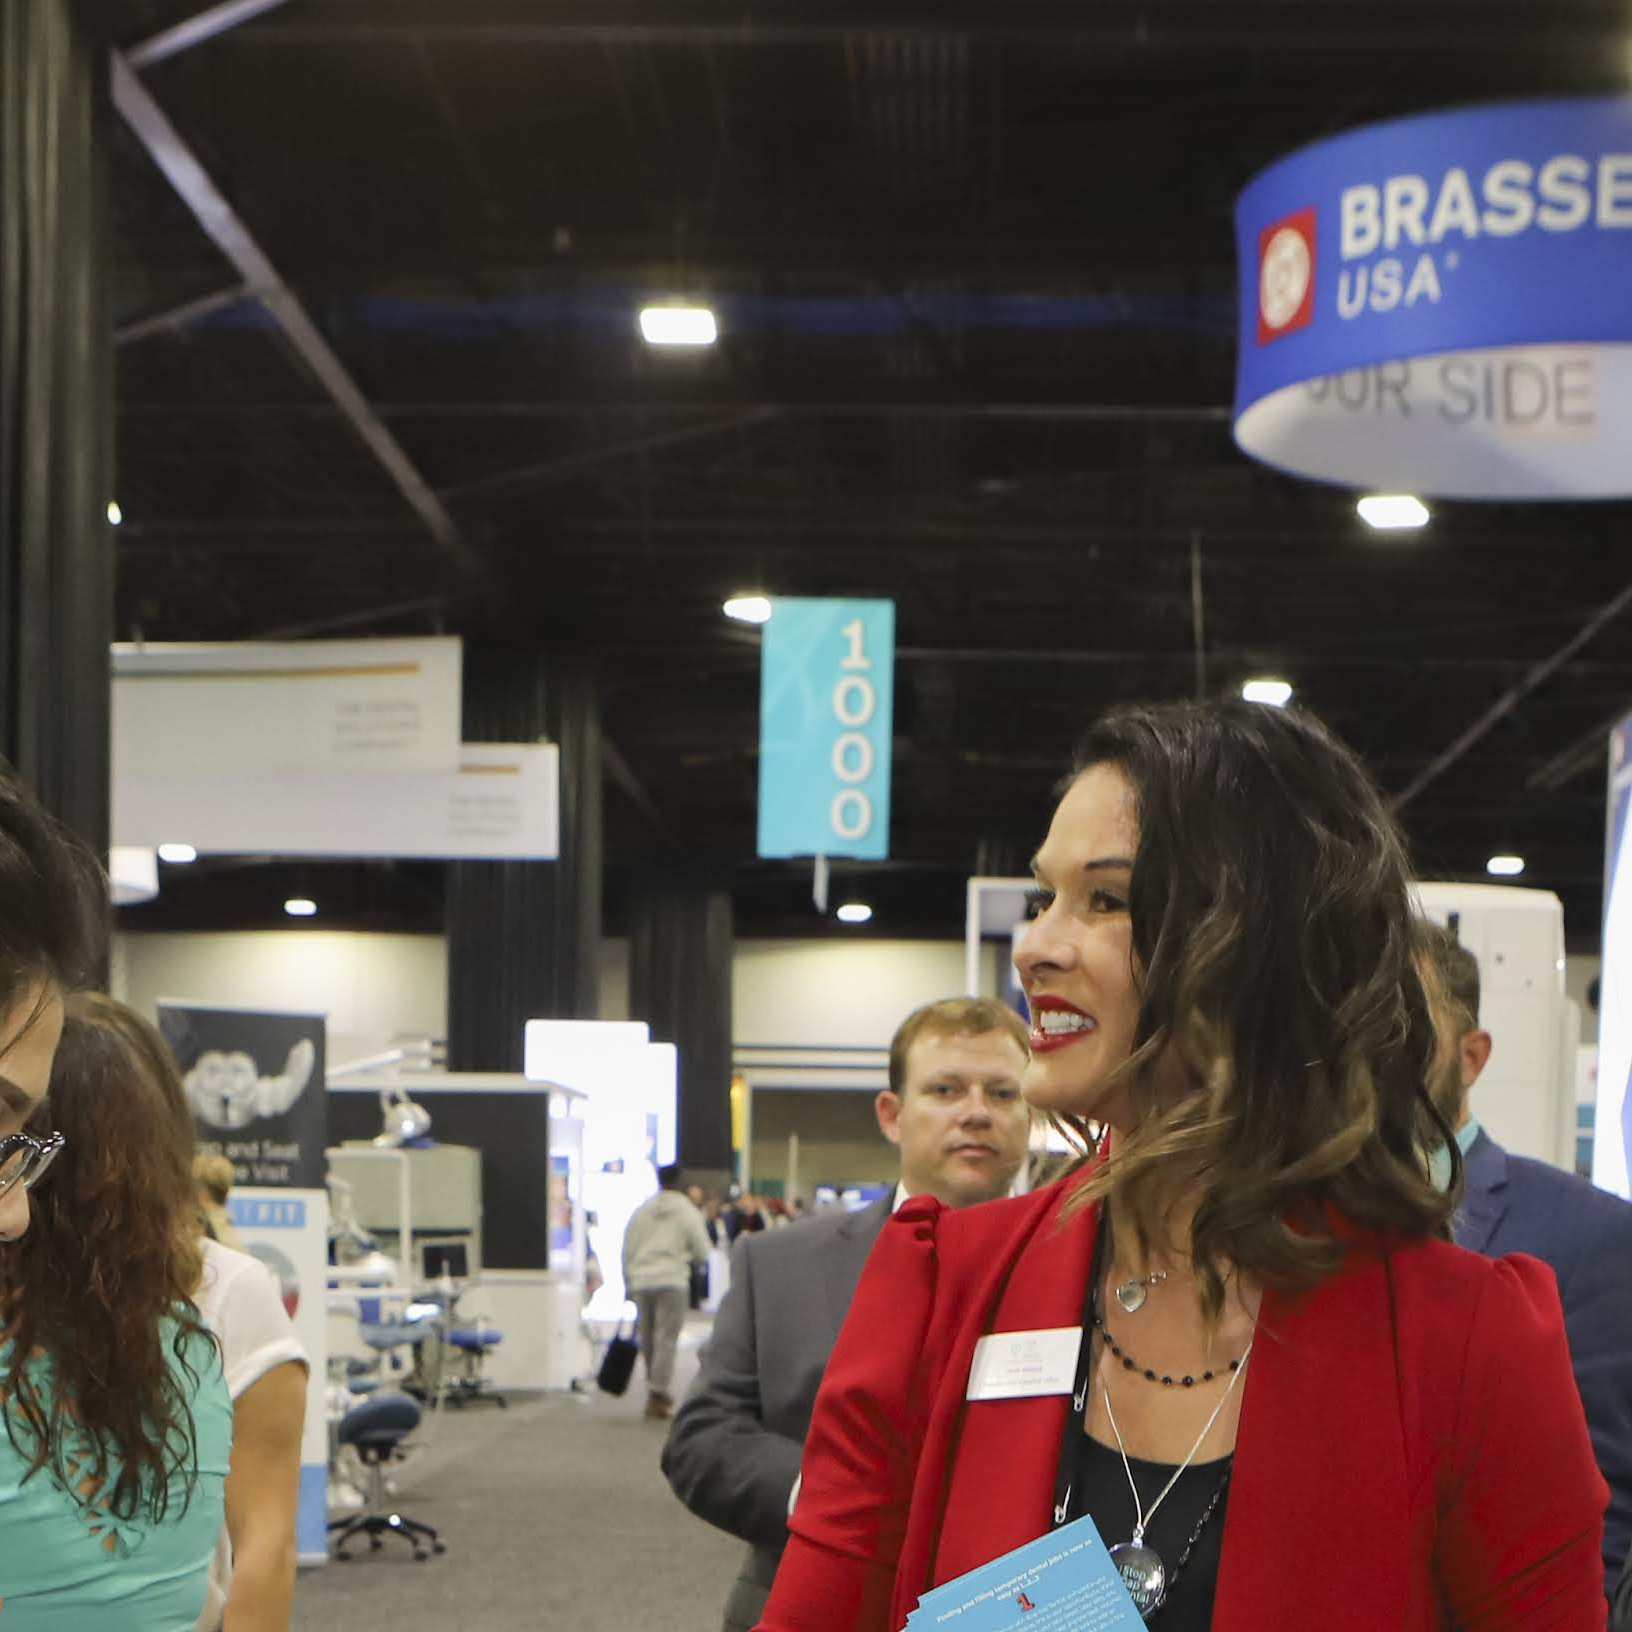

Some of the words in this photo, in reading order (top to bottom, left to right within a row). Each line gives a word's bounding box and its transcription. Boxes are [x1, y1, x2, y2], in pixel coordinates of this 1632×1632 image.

[1438, 355, 1596, 426] SIDE
[830, 617, 876, 839] 1000
[1016, 1592, 1036, 1613] 1
